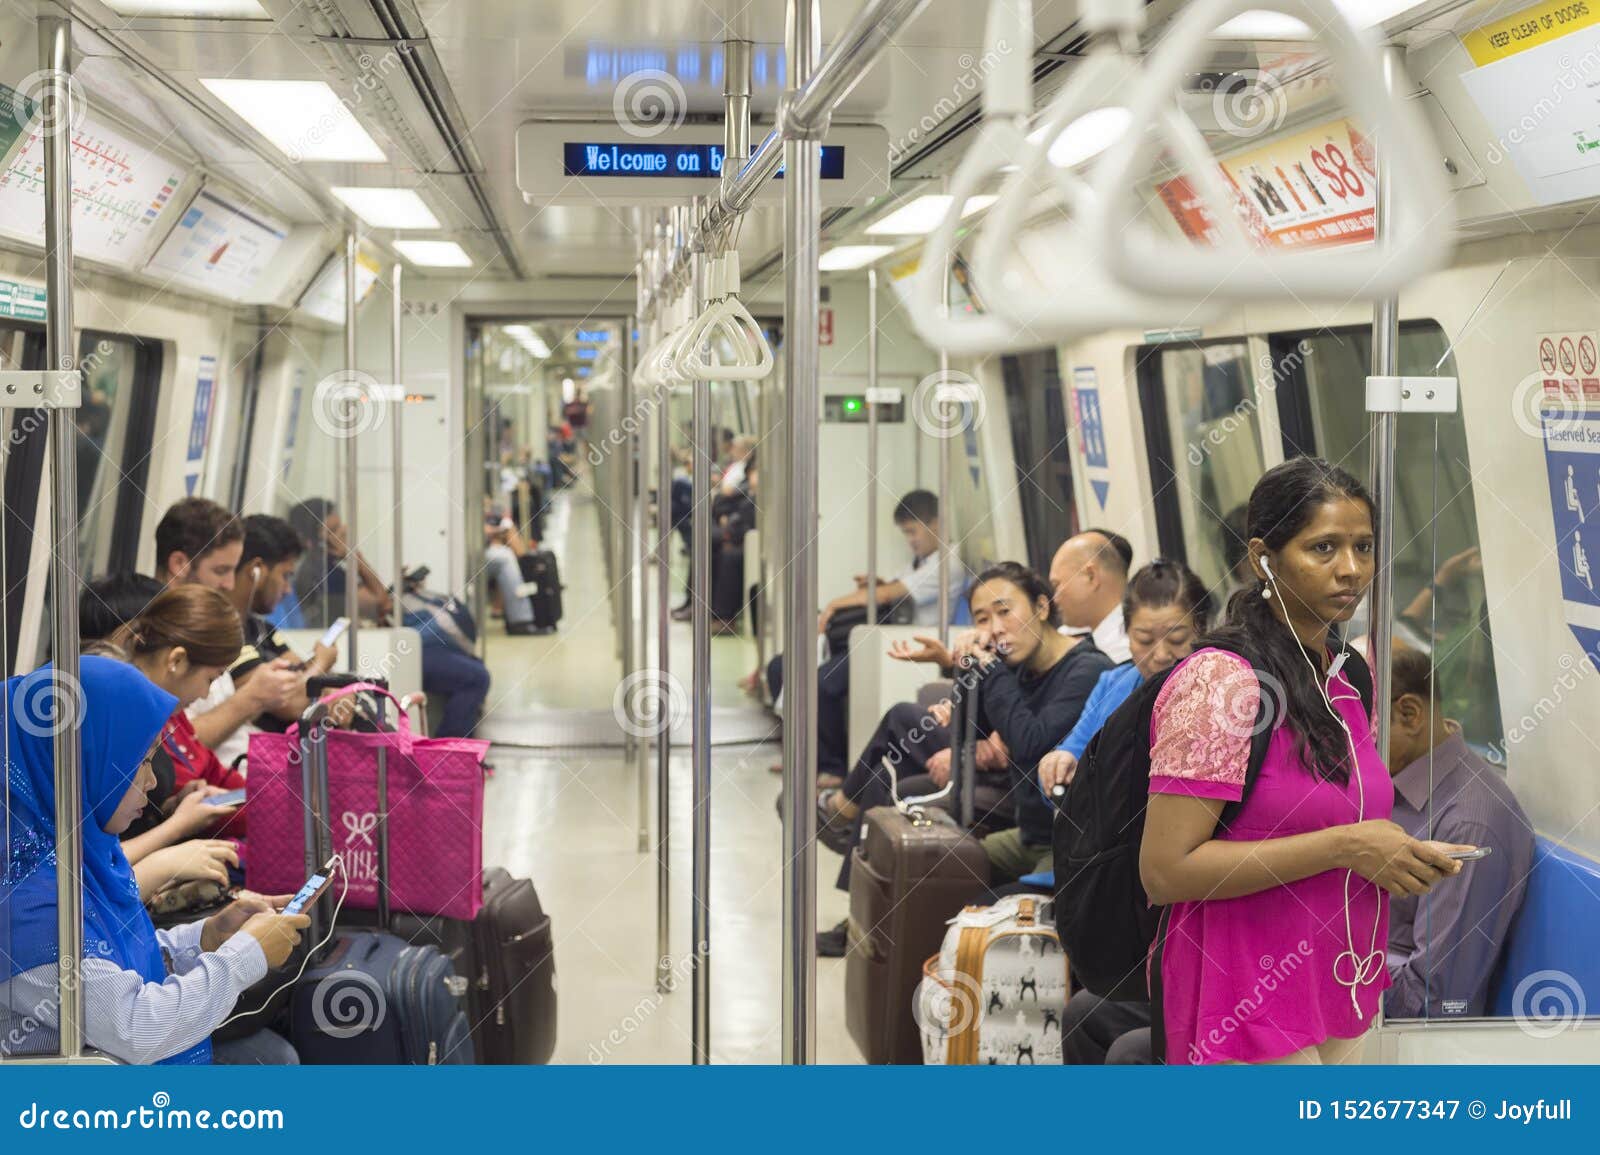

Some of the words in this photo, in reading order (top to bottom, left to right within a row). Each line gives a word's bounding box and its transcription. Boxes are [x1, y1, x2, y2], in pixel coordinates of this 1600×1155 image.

[1489, 31, 1510, 49] KEEP
[1511, 21, 1539, 41] CLEAR
[1540, 14, 1553, 30] OF
[1554, 1, 1590, 24] DOORS
[586, 145, 668, 171] Welcome
[677, 153, 700, 171] on
[1586, 426, 1600, 443] Sea
